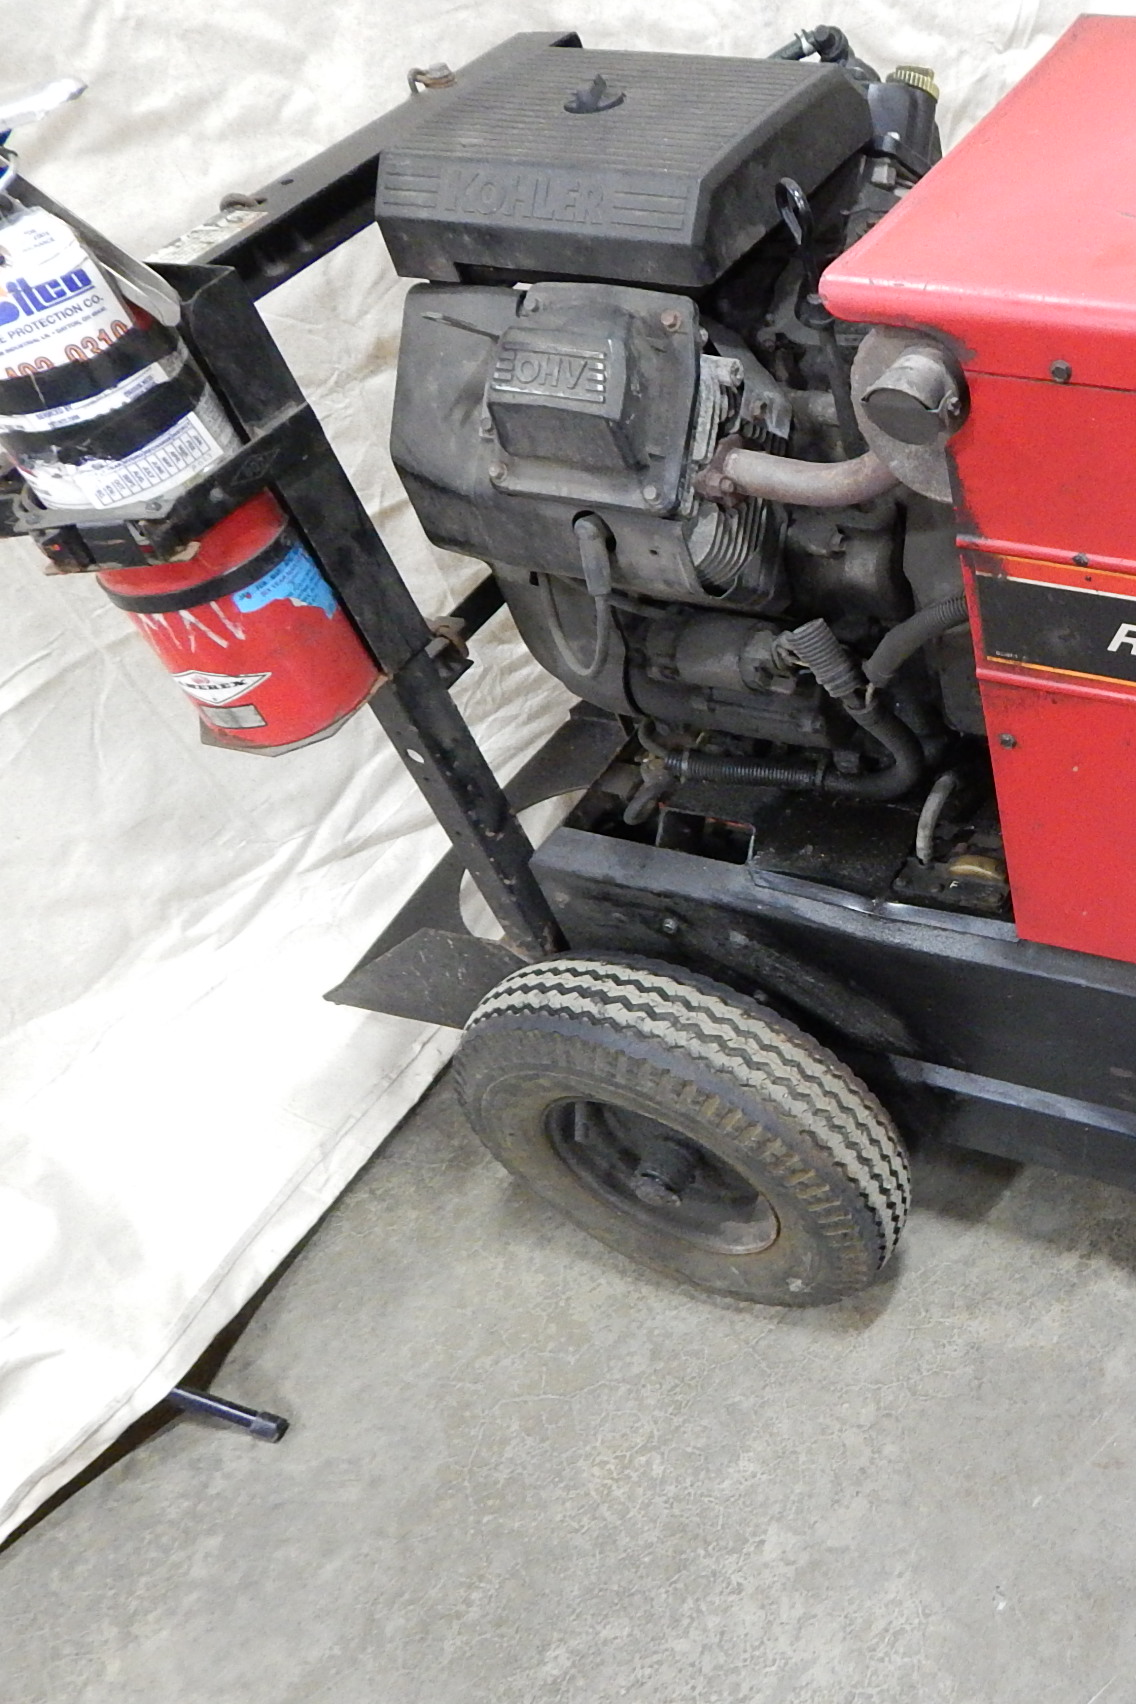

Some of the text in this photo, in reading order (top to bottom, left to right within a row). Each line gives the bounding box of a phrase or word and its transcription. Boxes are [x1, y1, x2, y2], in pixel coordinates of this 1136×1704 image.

[443, 169, 606, 225] KOHLER
[7, 301, 83, 340] PROTECTION
[83, 293, 105, 309] CO.
[516, 349, 590, 391] OHV
